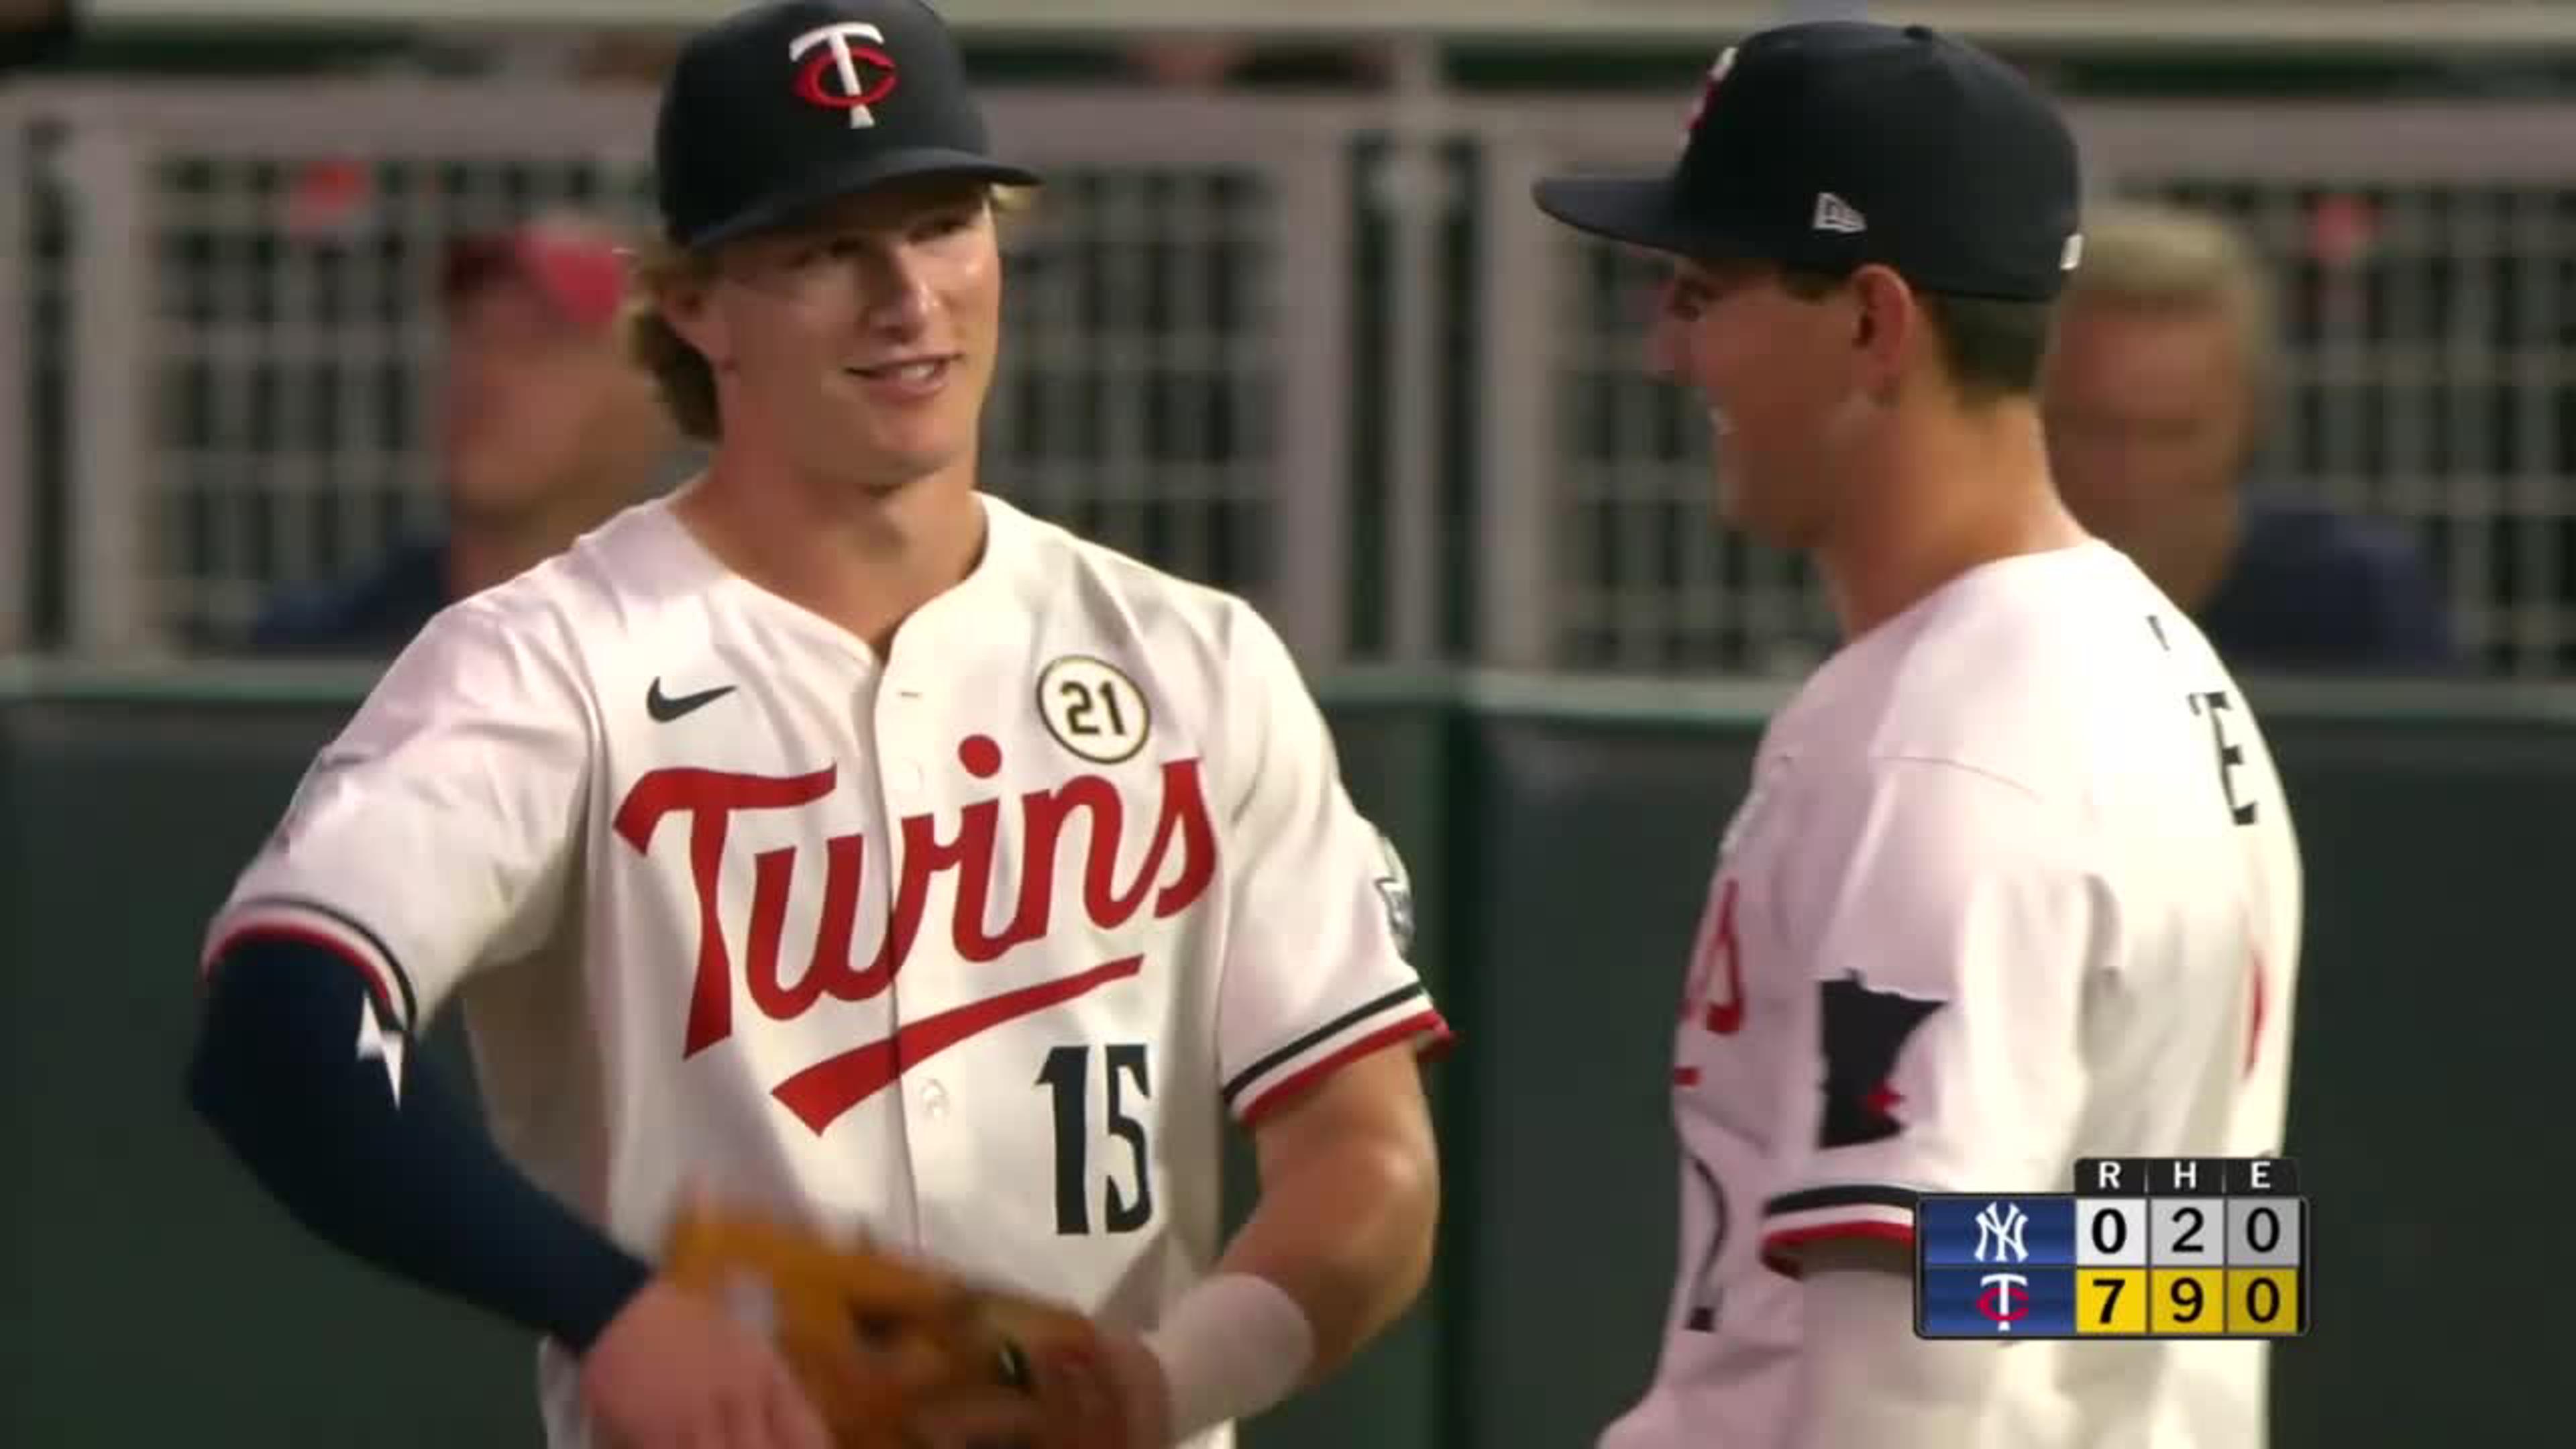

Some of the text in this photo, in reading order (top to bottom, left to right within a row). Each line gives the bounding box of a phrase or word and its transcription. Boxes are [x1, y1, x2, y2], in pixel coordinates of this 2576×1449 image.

[1059, 679, 1126, 737] 21
[613, 734, 1216, 1061] Twins
[1034, 1043, 1152, 1236] 15
